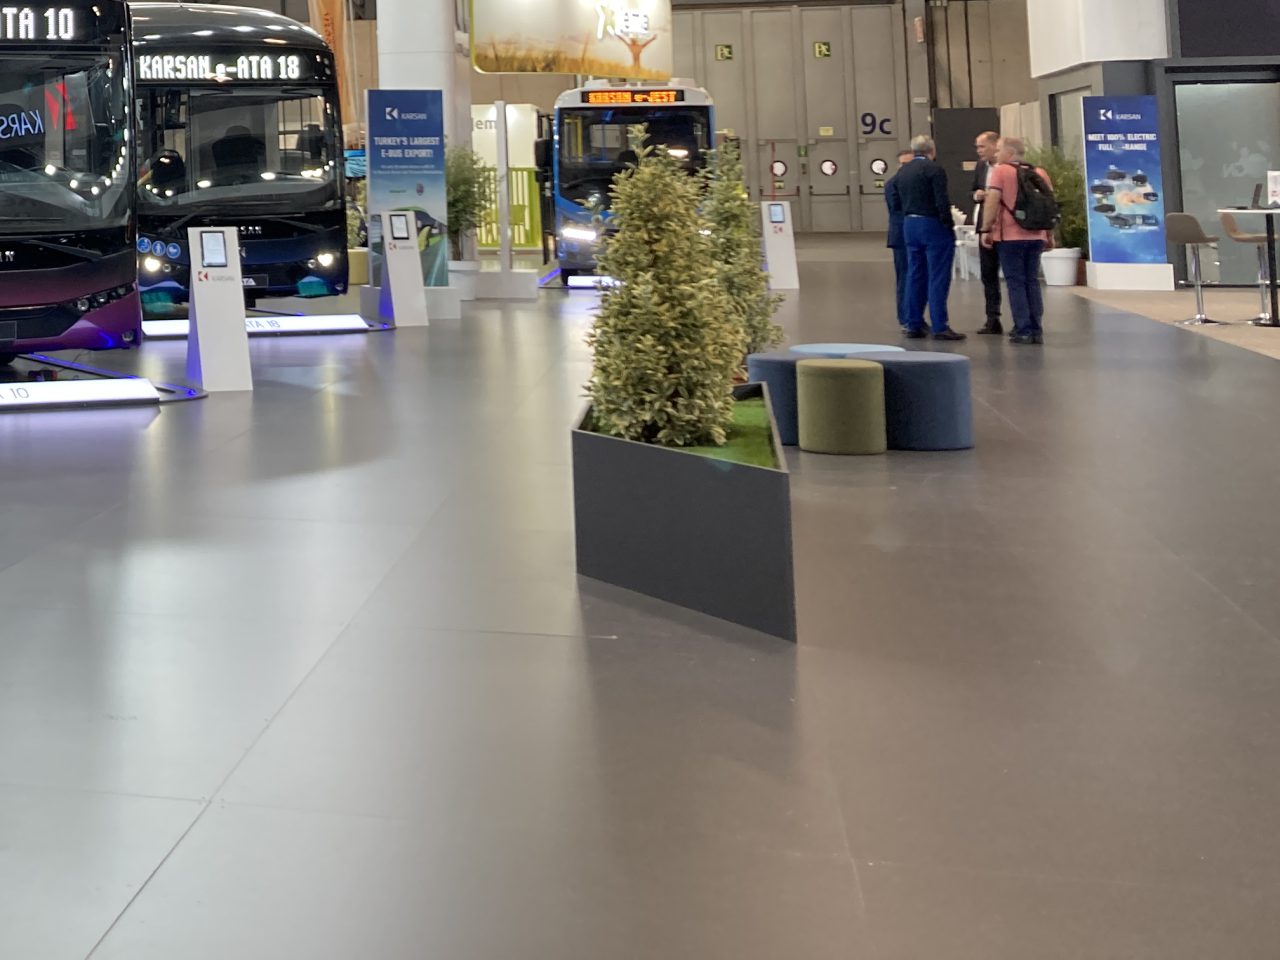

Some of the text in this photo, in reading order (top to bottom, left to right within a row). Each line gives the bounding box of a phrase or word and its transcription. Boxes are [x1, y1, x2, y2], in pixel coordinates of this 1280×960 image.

[44, 8, 75, 39] 10
[139, 55, 300, 80] KARSAN e-ATA 18
[861, 112, 892, 135] 9c
[374, 136, 440, 145] TURKEY'S LARGEST
